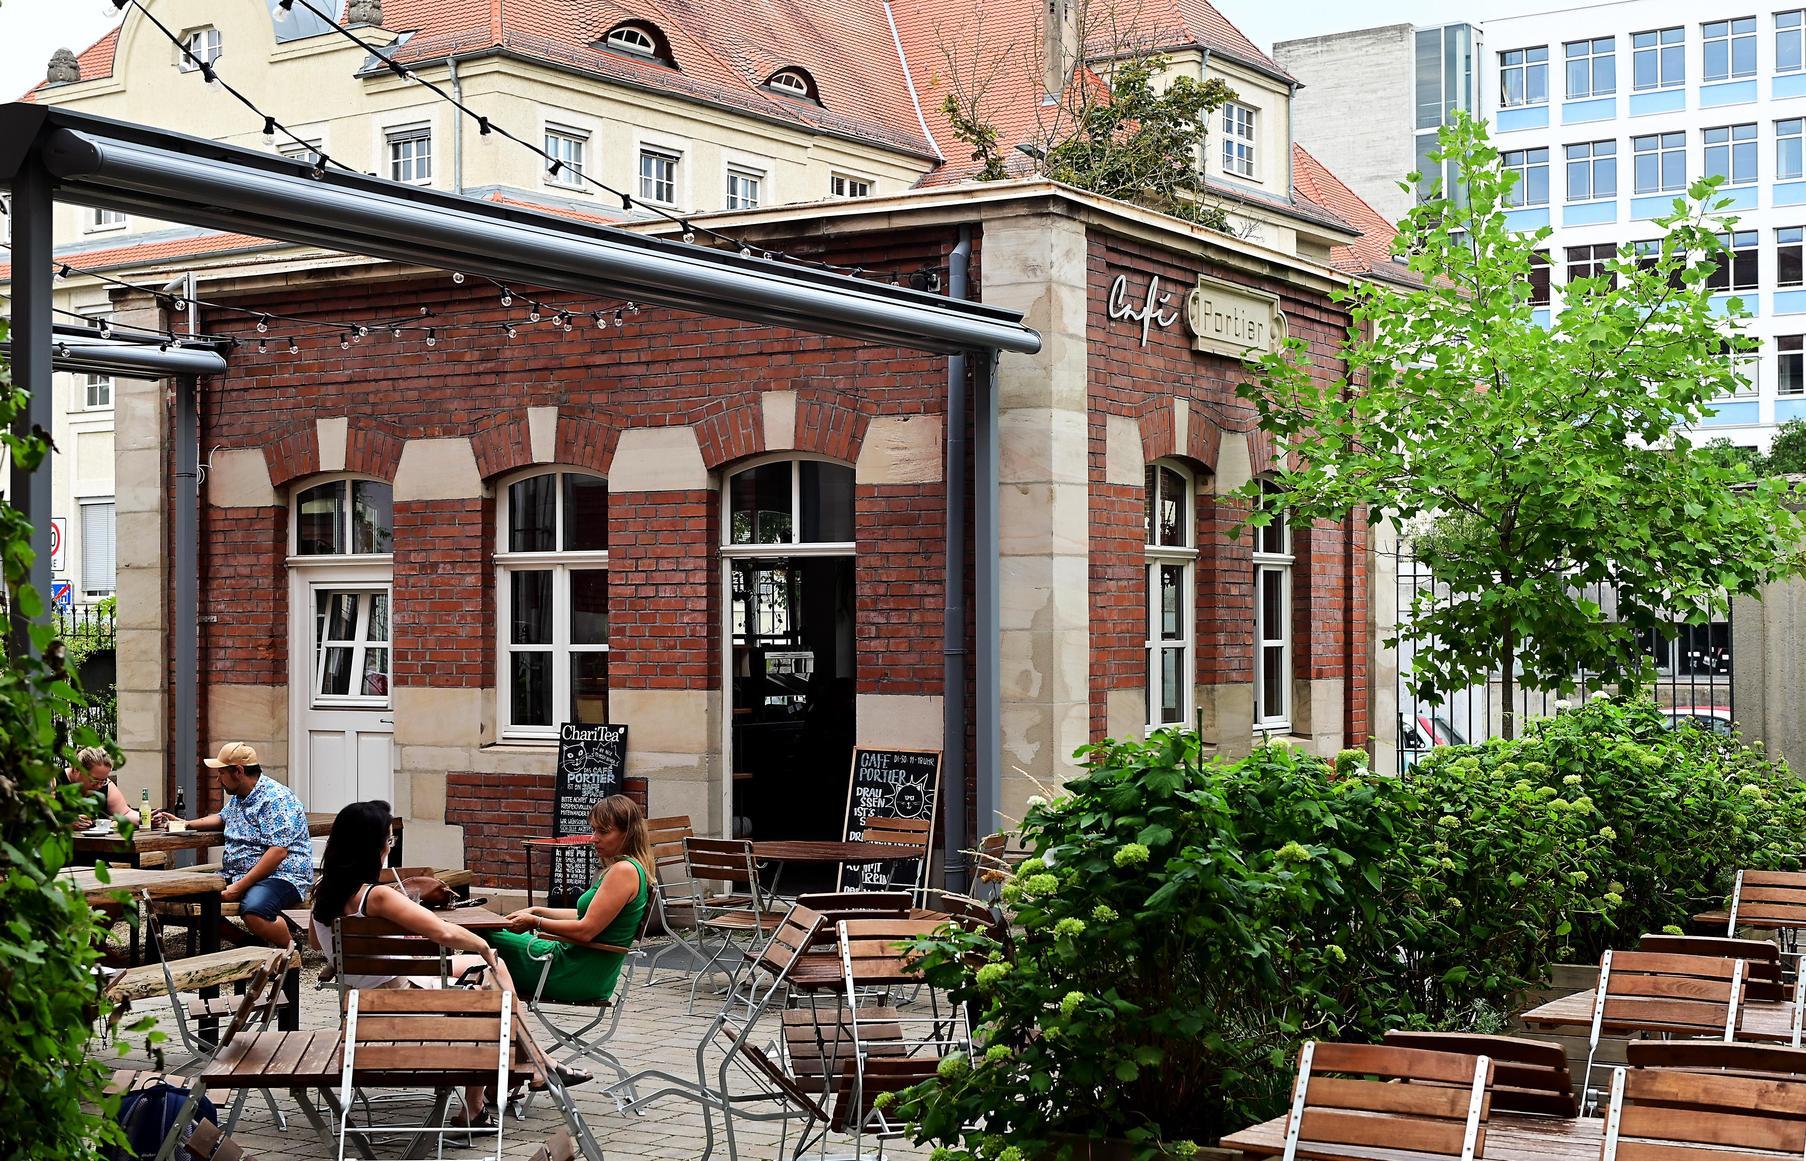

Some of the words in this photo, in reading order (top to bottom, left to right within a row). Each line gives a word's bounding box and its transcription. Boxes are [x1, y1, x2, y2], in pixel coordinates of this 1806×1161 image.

[1109, 274, 1179, 347] Café
[1203, 300, 1264, 342] Portier
[562, 725, 620, 742] ChariTea
[567, 772, 616, 784] PORTIER
[859, 767, 907, 785] PORTIER
[856, 787, 882, 798] DRAU
[860, 797, 886, 808] SSEN
